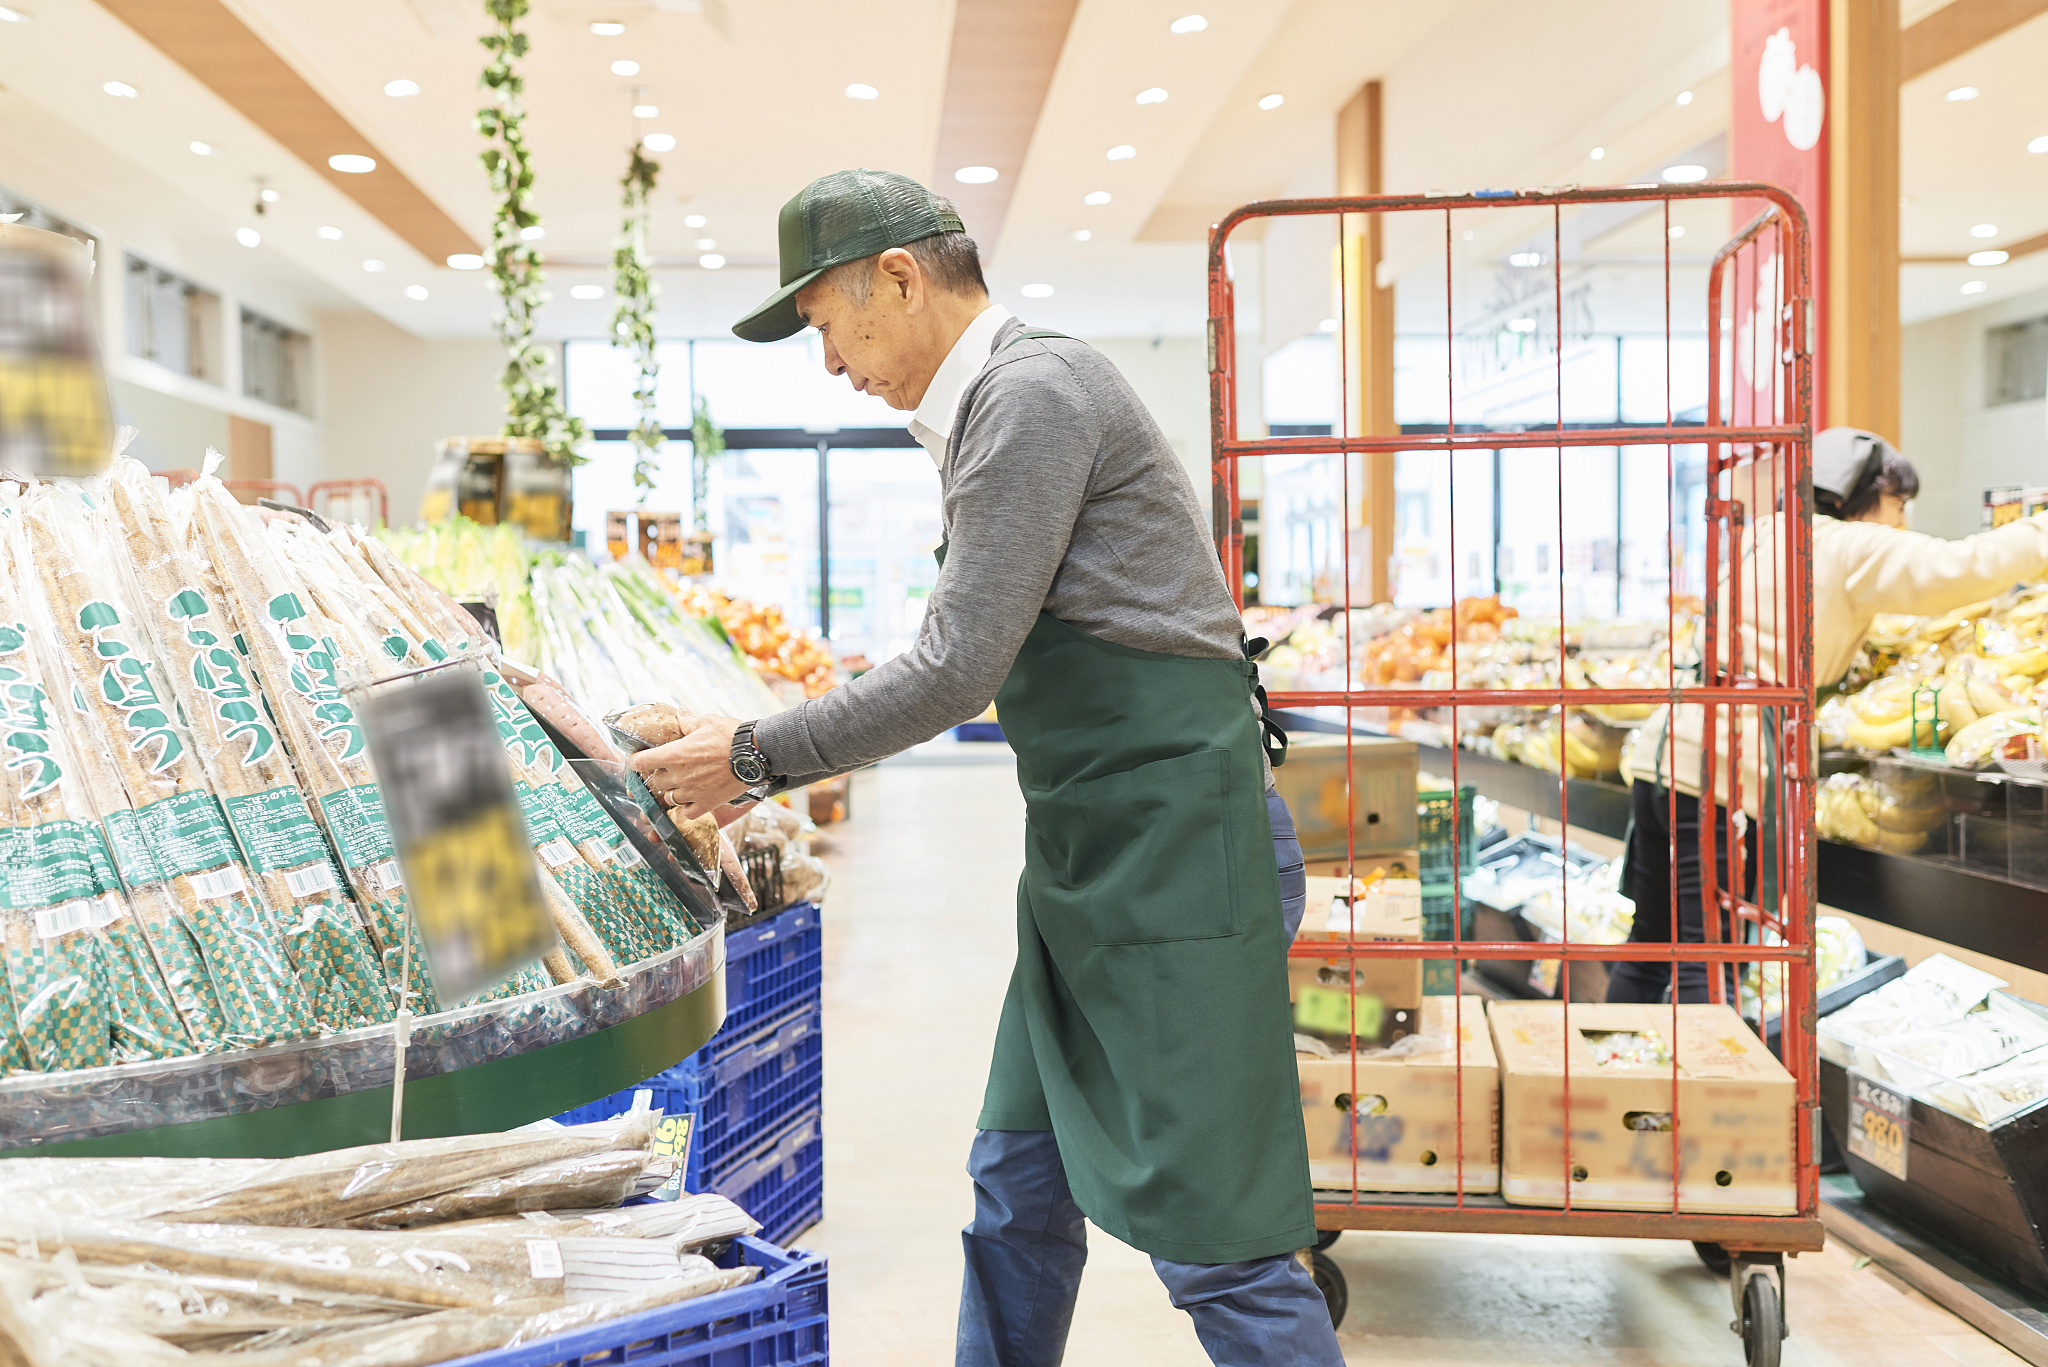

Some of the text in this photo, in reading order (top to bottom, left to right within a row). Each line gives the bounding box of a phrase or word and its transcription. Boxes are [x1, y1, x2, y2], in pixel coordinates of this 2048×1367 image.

[154, 791, 207, 814] ごぼうのサラ
[1863, 1110, 1903, 1155] 980
